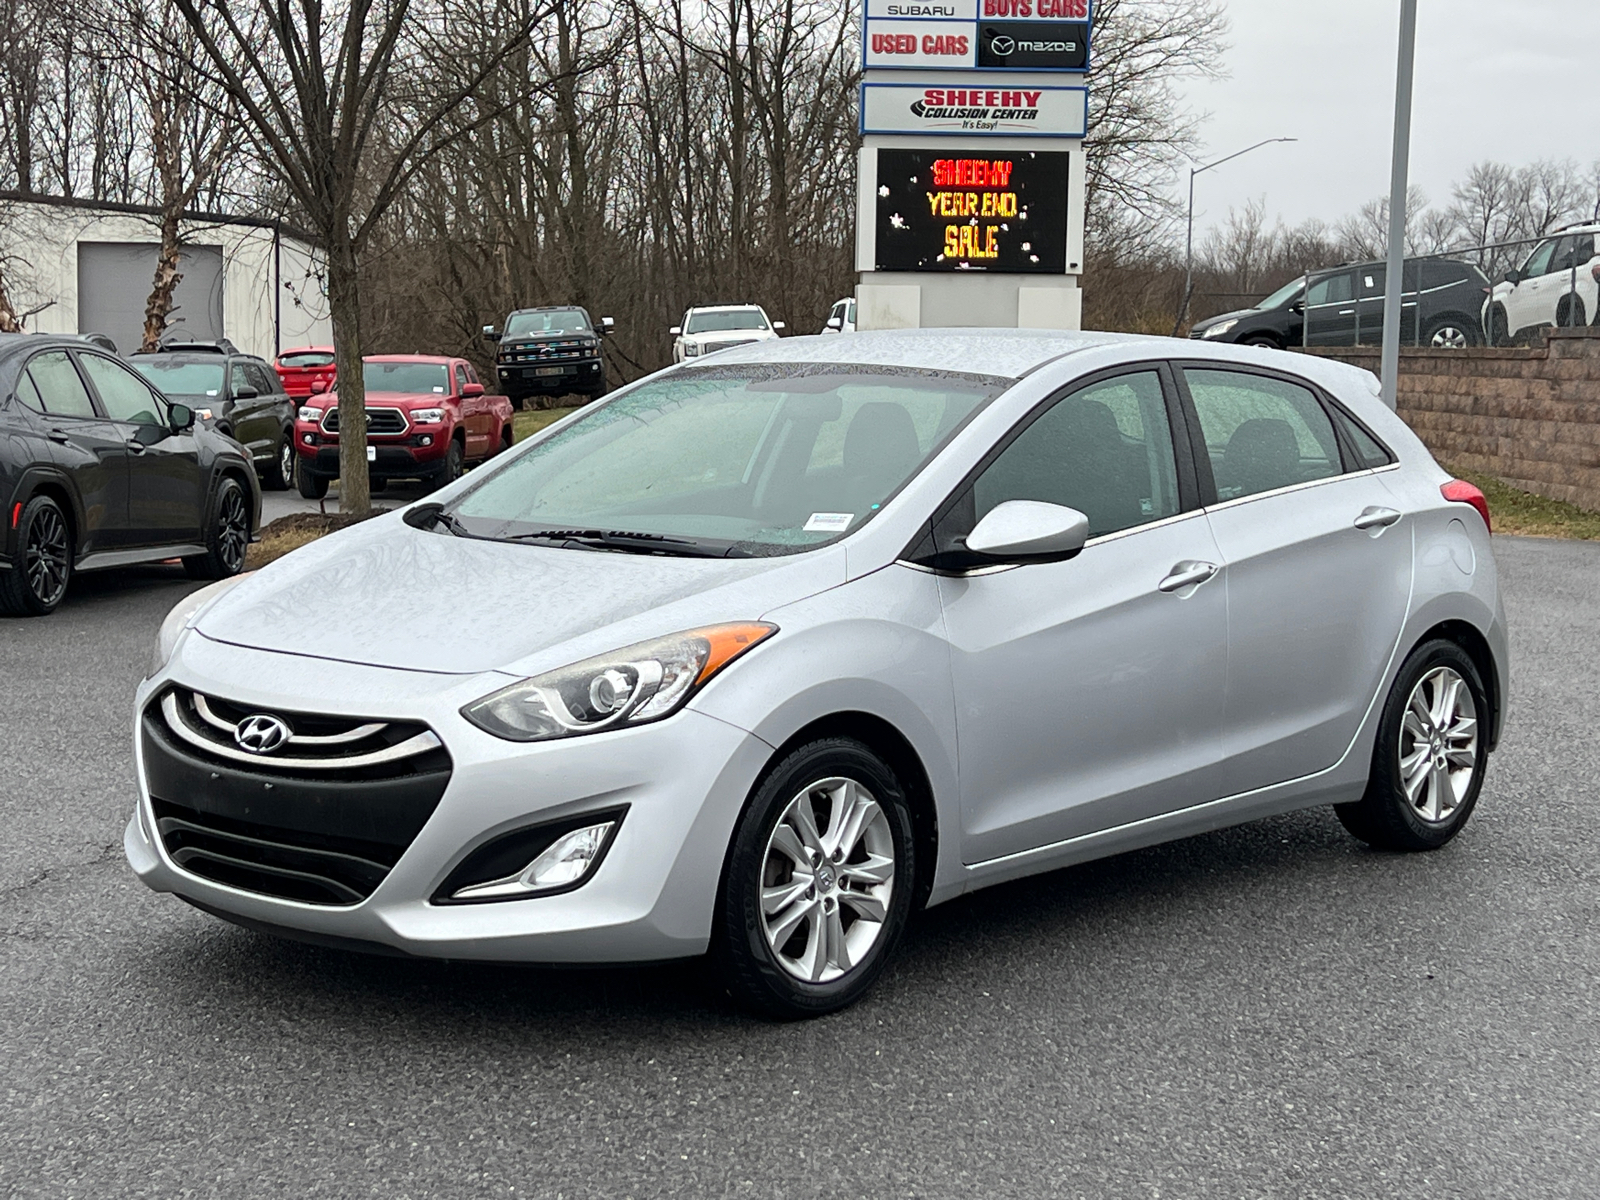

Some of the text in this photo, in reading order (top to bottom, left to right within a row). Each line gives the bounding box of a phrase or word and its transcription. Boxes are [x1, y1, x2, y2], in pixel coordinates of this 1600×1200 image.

[888, 5, 954, 16] SUBARU
[984, 0, 1087, 18] BUYS CARS
[872, 33, 969, 55] USED CARS
[924, 90, 1042, 107] SHEEHY
[924, 107, 1039, 120] COLLISION CENTER
[962, 120, 998, 131] It's Easy!
[932, 159, 1013, 186] SHEEHY
[926, 191, 1017, 217] YEAR END
[944, 225, 999, 258] SALE
